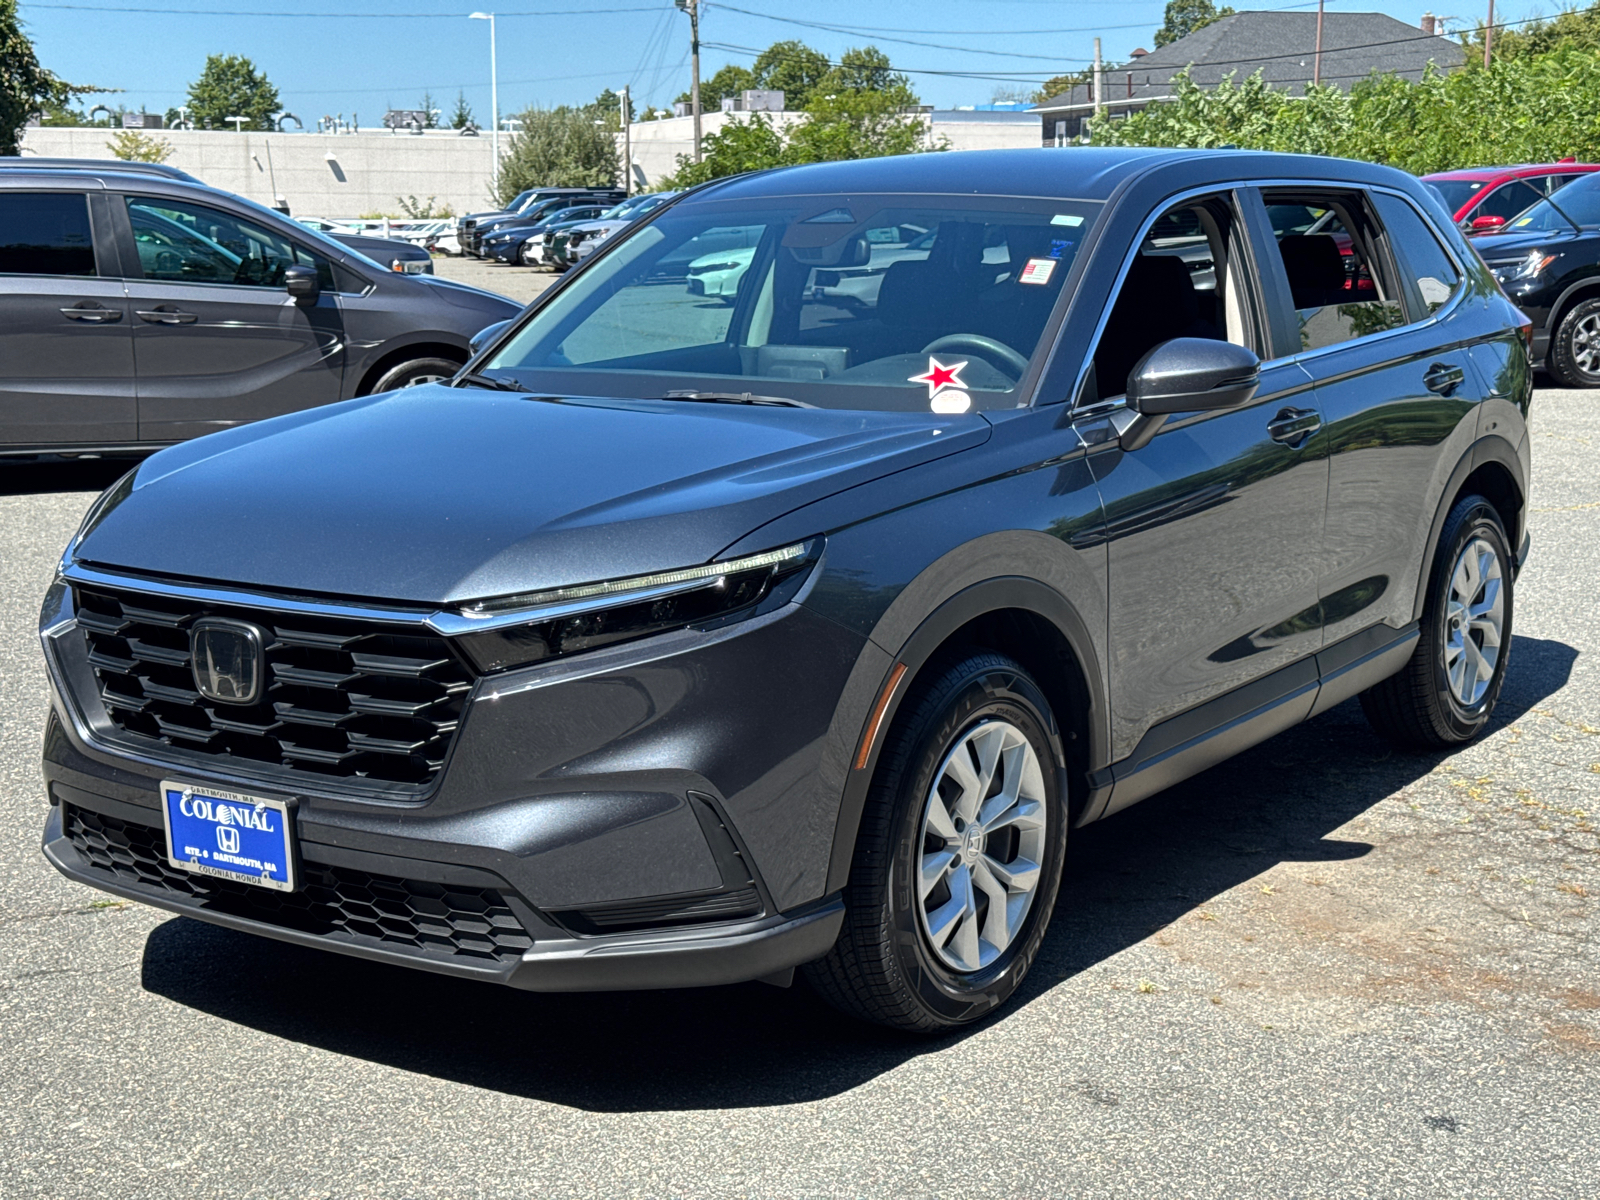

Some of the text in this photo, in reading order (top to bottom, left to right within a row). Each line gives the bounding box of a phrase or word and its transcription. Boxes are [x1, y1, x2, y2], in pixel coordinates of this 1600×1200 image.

[242, 795, 255, 803] MA
[179, 797, 274, 833] COLONIAL
[203, 850, 209, 858] 6
[213, 852, 264, 870] DARTMOUTH,
[264, 862, 277, 873] MA
[198, 865, 262, 884] COLONIAL HONDA
